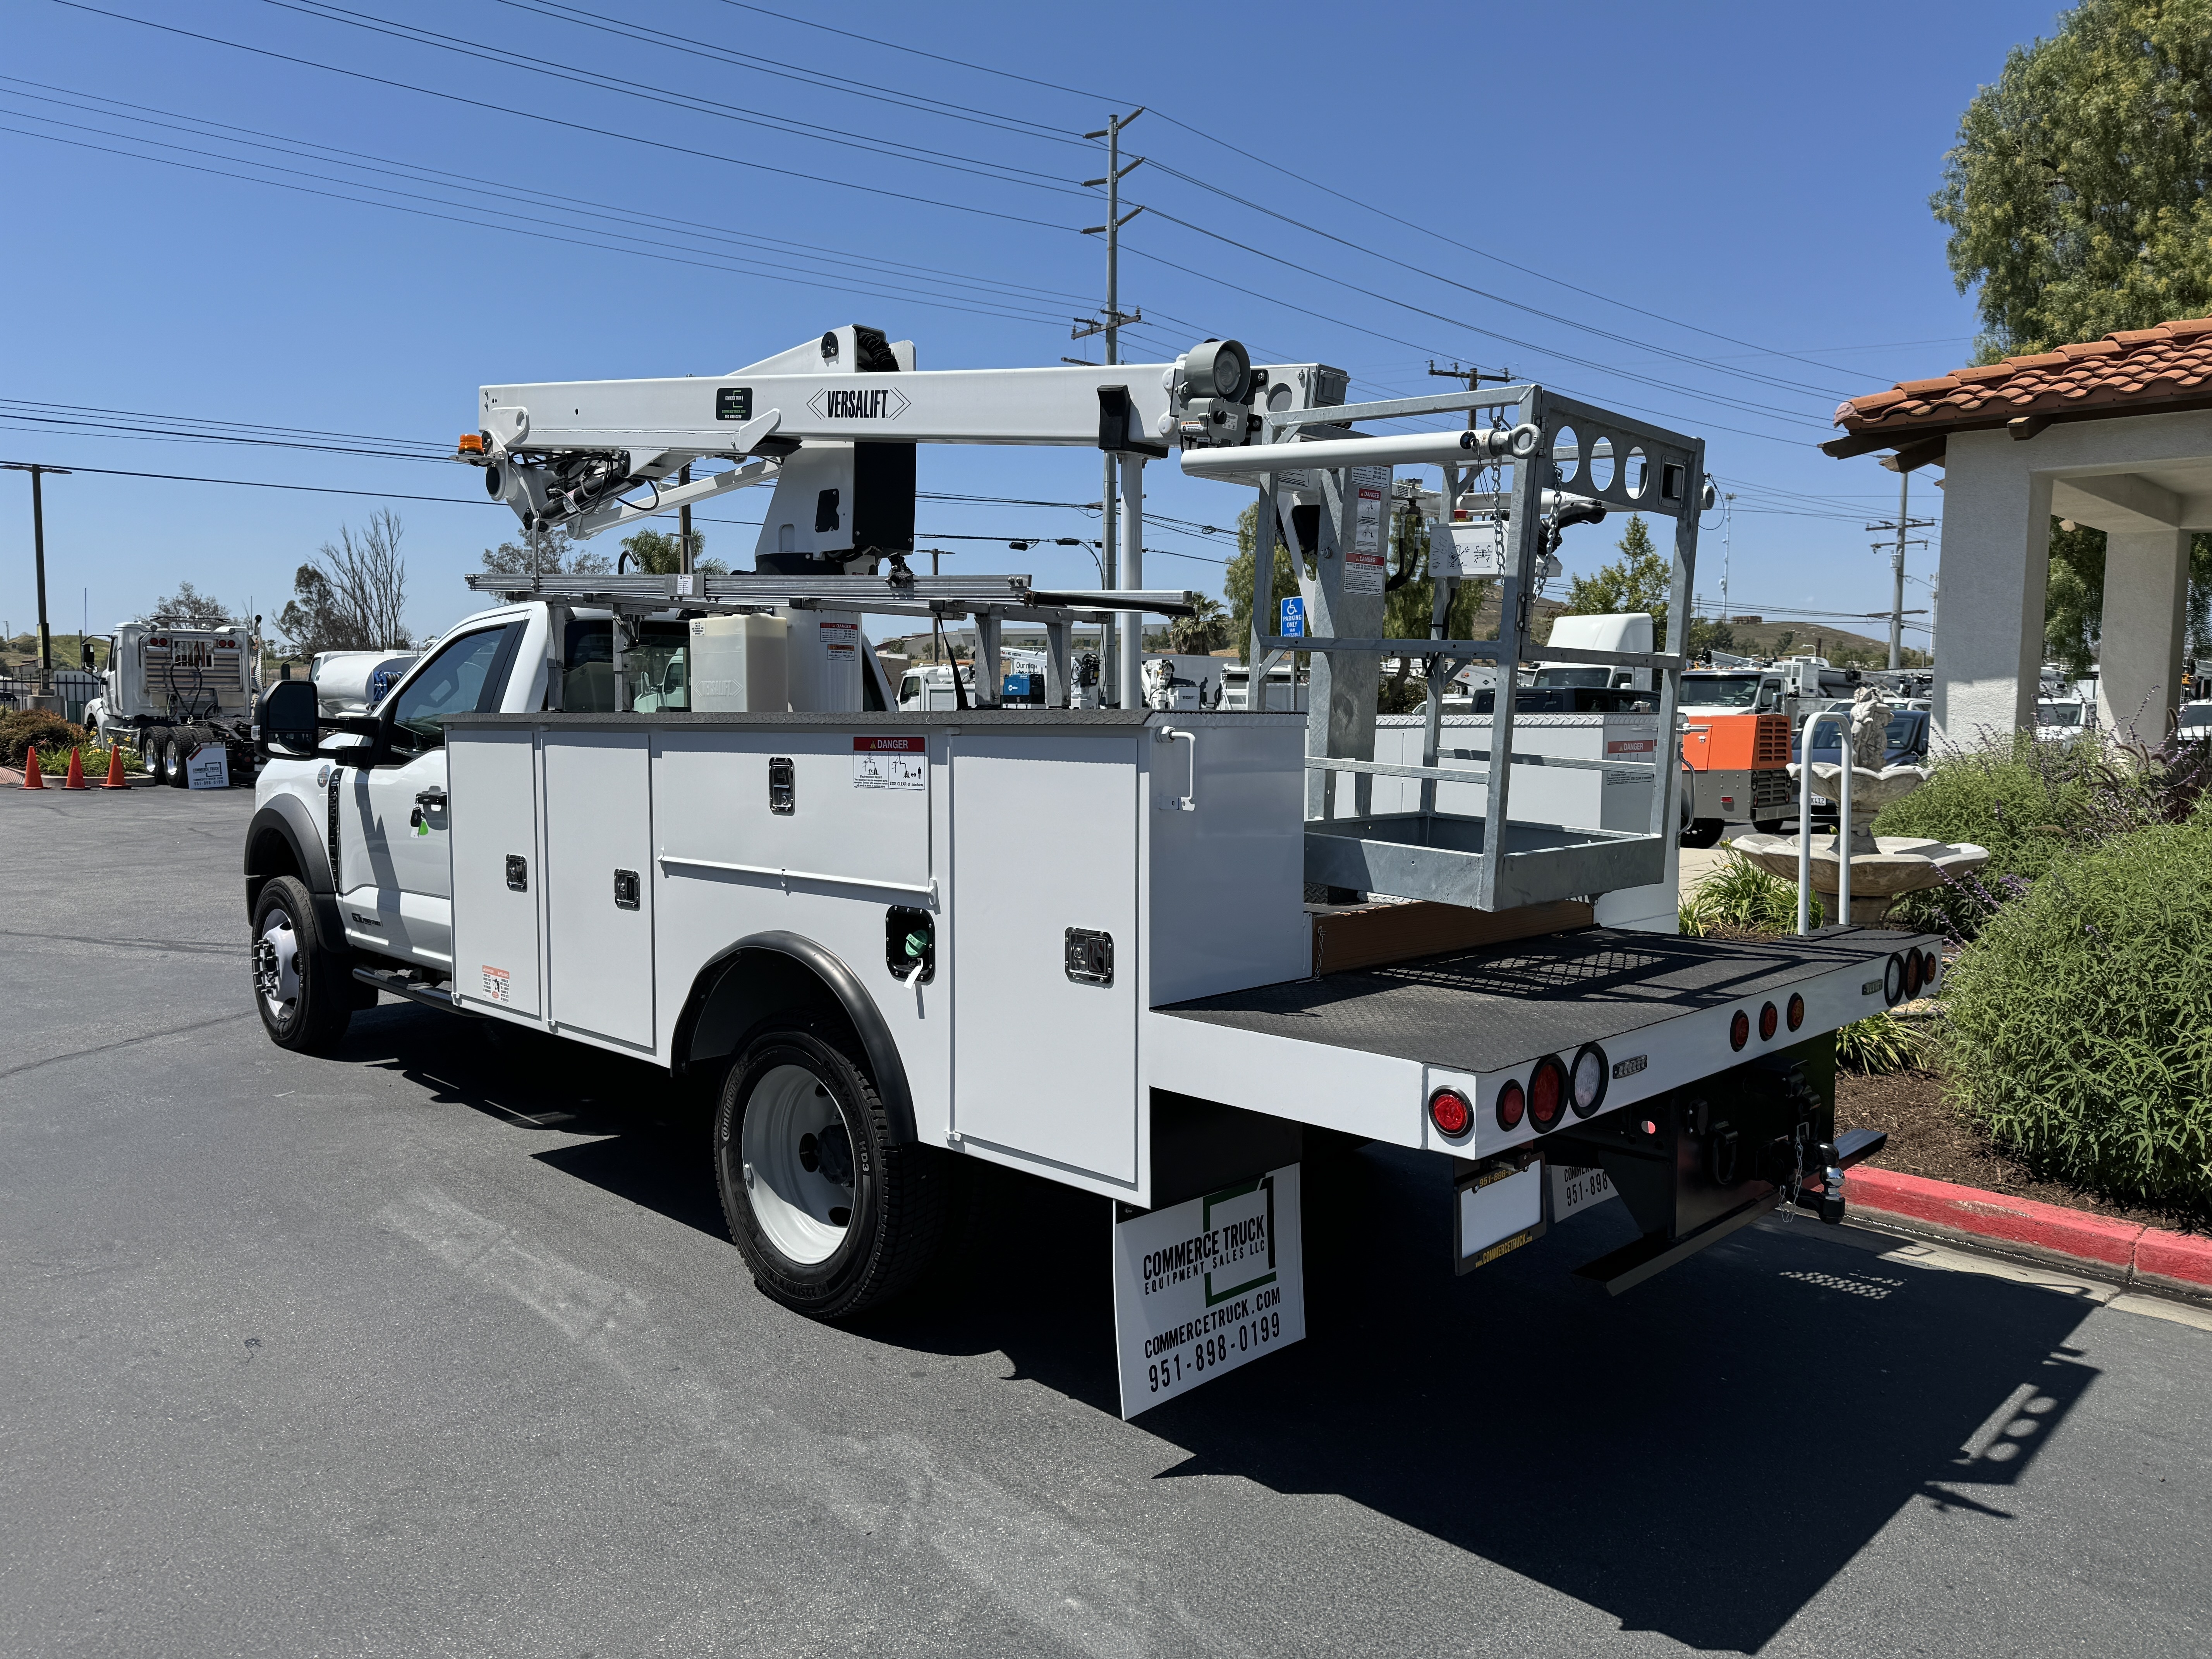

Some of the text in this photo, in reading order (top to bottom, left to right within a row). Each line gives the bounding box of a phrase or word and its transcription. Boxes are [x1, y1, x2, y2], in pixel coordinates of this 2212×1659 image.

[828, 390, 888, 418] VERSALIFT
[878, 740, 908, 749] DANGER
[859, 1140, 870, 1172] HD3
[1479, 1169, 1520, 1187] 951-898-0
[1143, 1214, 1265, 1280] COMMERCE TRUCK
[1145, 1240, 1265, 1295] EQUIPMENT SALES LLC
[787, 1283, 817, 1298] 225/70
[1145, 1286, 1280, 1359] COMMERCETRUCK.COM
[1149, 1312, 1280, 1393] 951-898-0199
